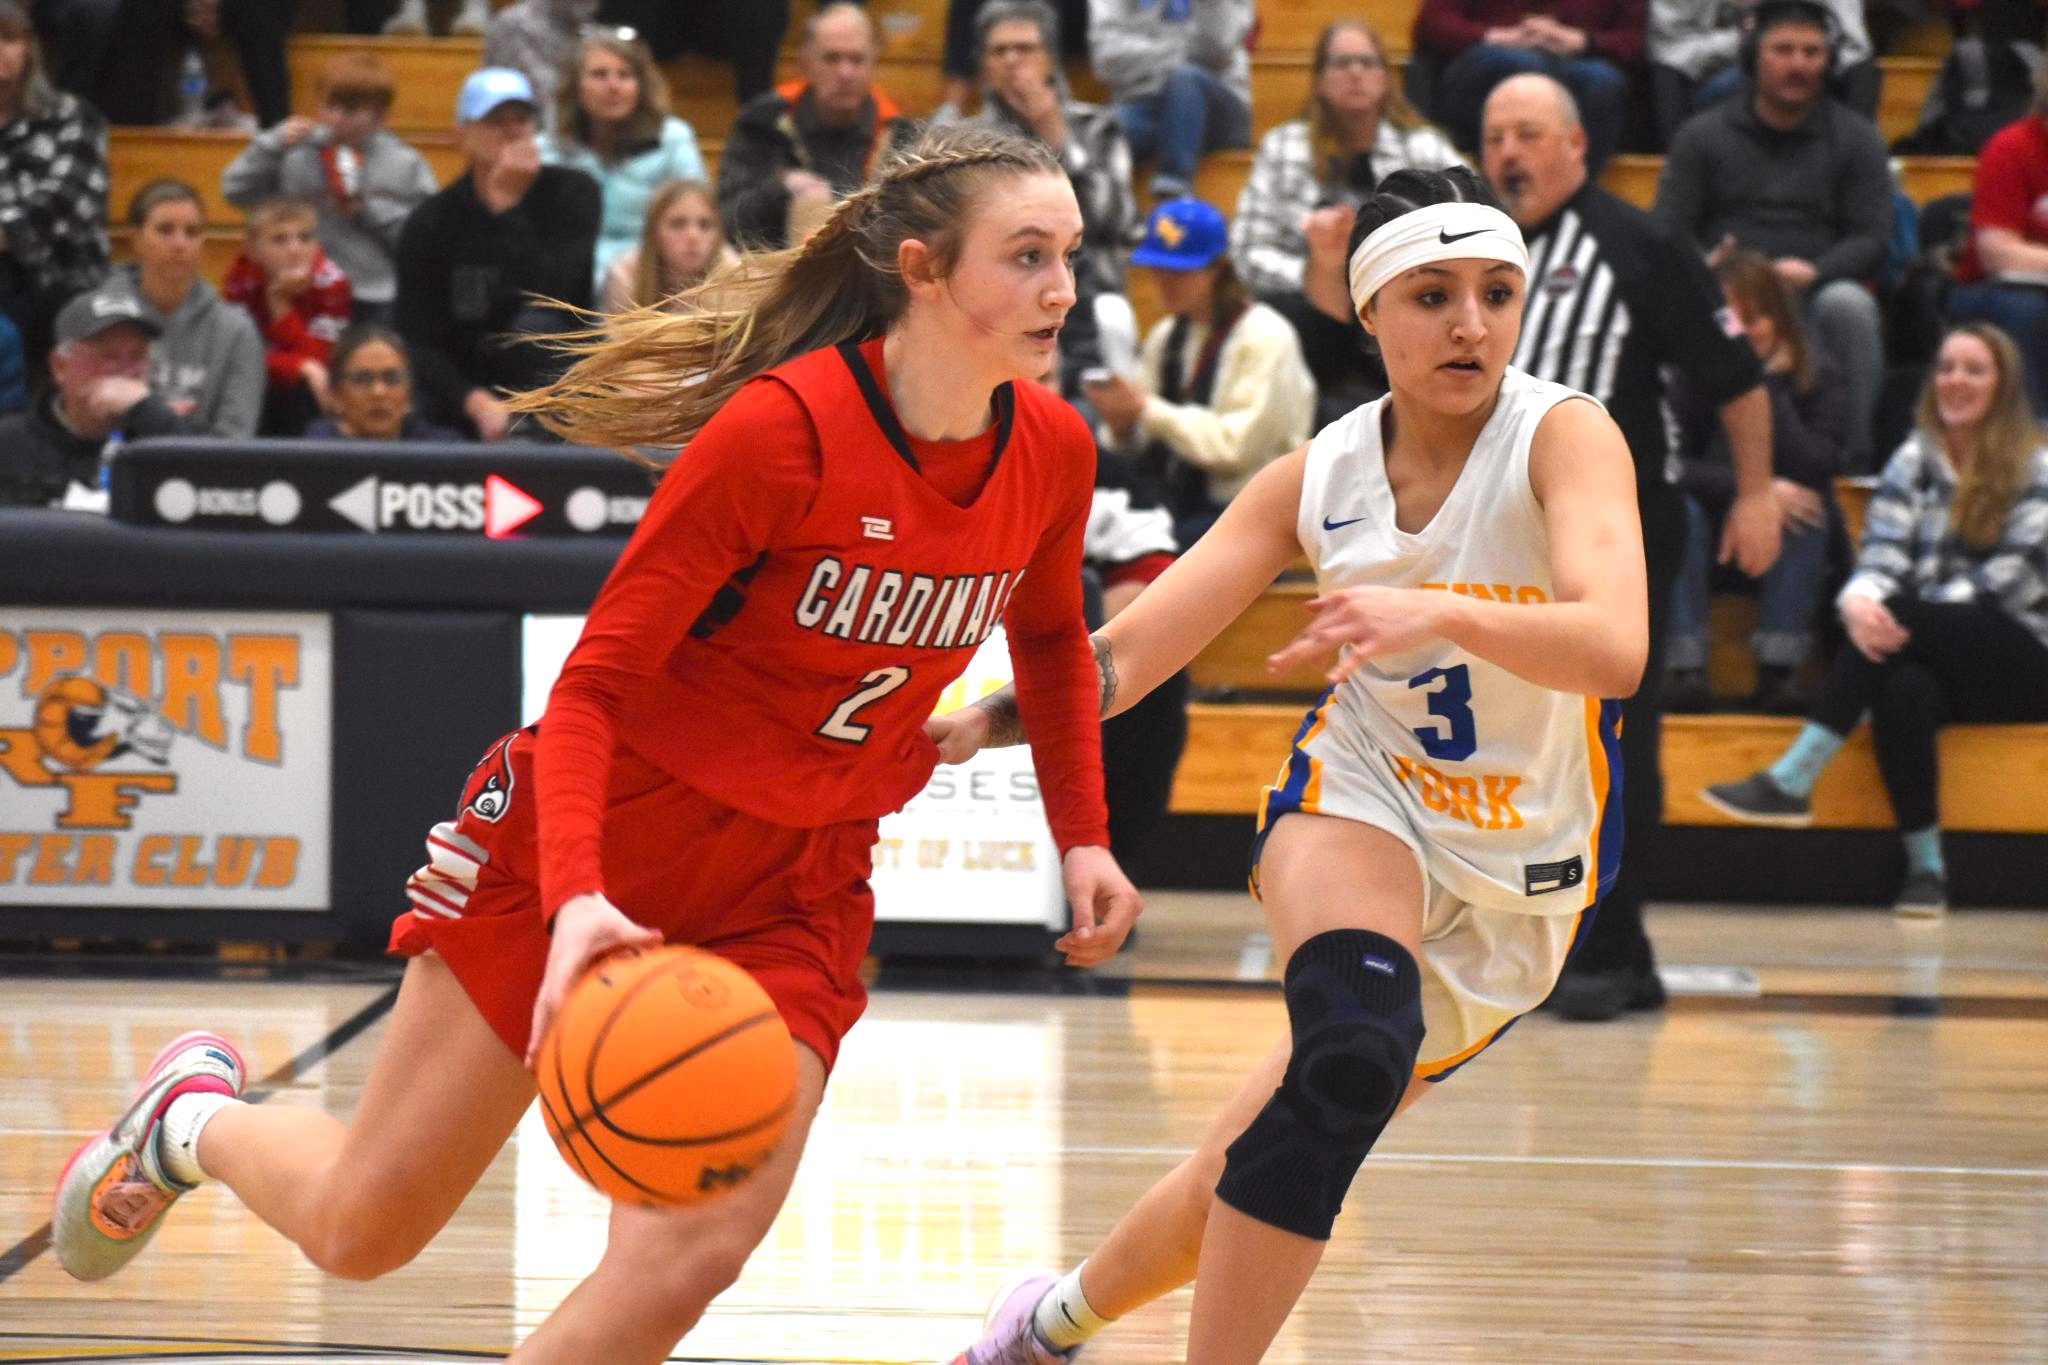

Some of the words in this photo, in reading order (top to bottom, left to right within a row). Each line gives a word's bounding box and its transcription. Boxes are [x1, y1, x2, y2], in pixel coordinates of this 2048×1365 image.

[381, 481, 485, 530] POSS
[795, 555, 1027, 649] CARDINAL
[814, 665, 912, 745] 2
[1408, 663, 1477, 762] 3
[132, 834, 302, 889] CLUB
[1567, 867, 1578, 881] S
